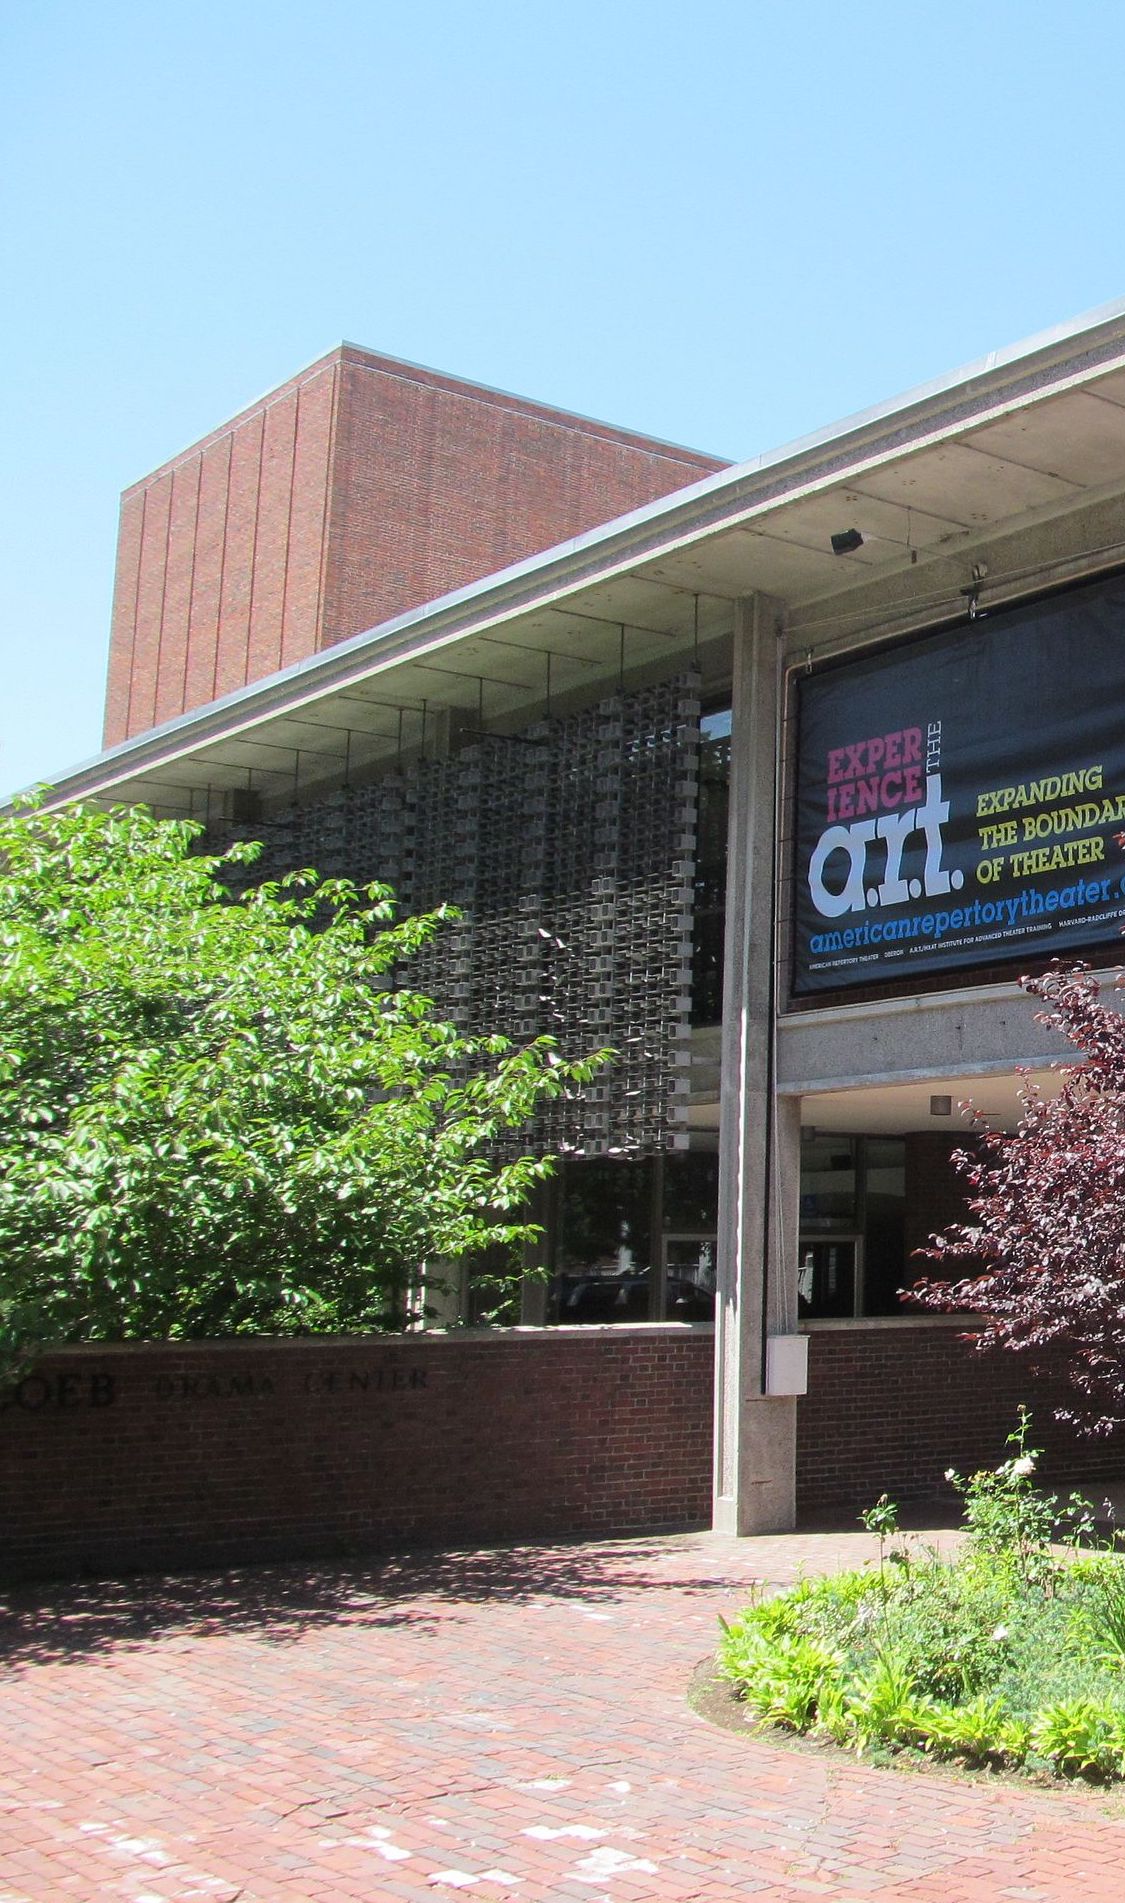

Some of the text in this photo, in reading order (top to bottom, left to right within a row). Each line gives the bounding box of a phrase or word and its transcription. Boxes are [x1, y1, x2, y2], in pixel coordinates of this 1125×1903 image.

[827, 727, 923, 784] EXPER
[926, 720, 942, 773] THE
[826, 765, 924, 823] IENCE
[976, 765, 1103, 817] EXPANDING
[976, 836, 1105, 884] OF THEATER
[978, 821, 1018, 850] THE
[963, 935, 975, 945] FOR
[975, 932, 1002, 942] ADVANCED
[1002, 927, 1026, 939] THEATER
[1026, 922, 1053, 934] TRAINING
[1058, 910, 1118, 928] HARVARD-RADCLIFFE
[0, 1367, 429, 1411] OEB DRAMA CENTER
